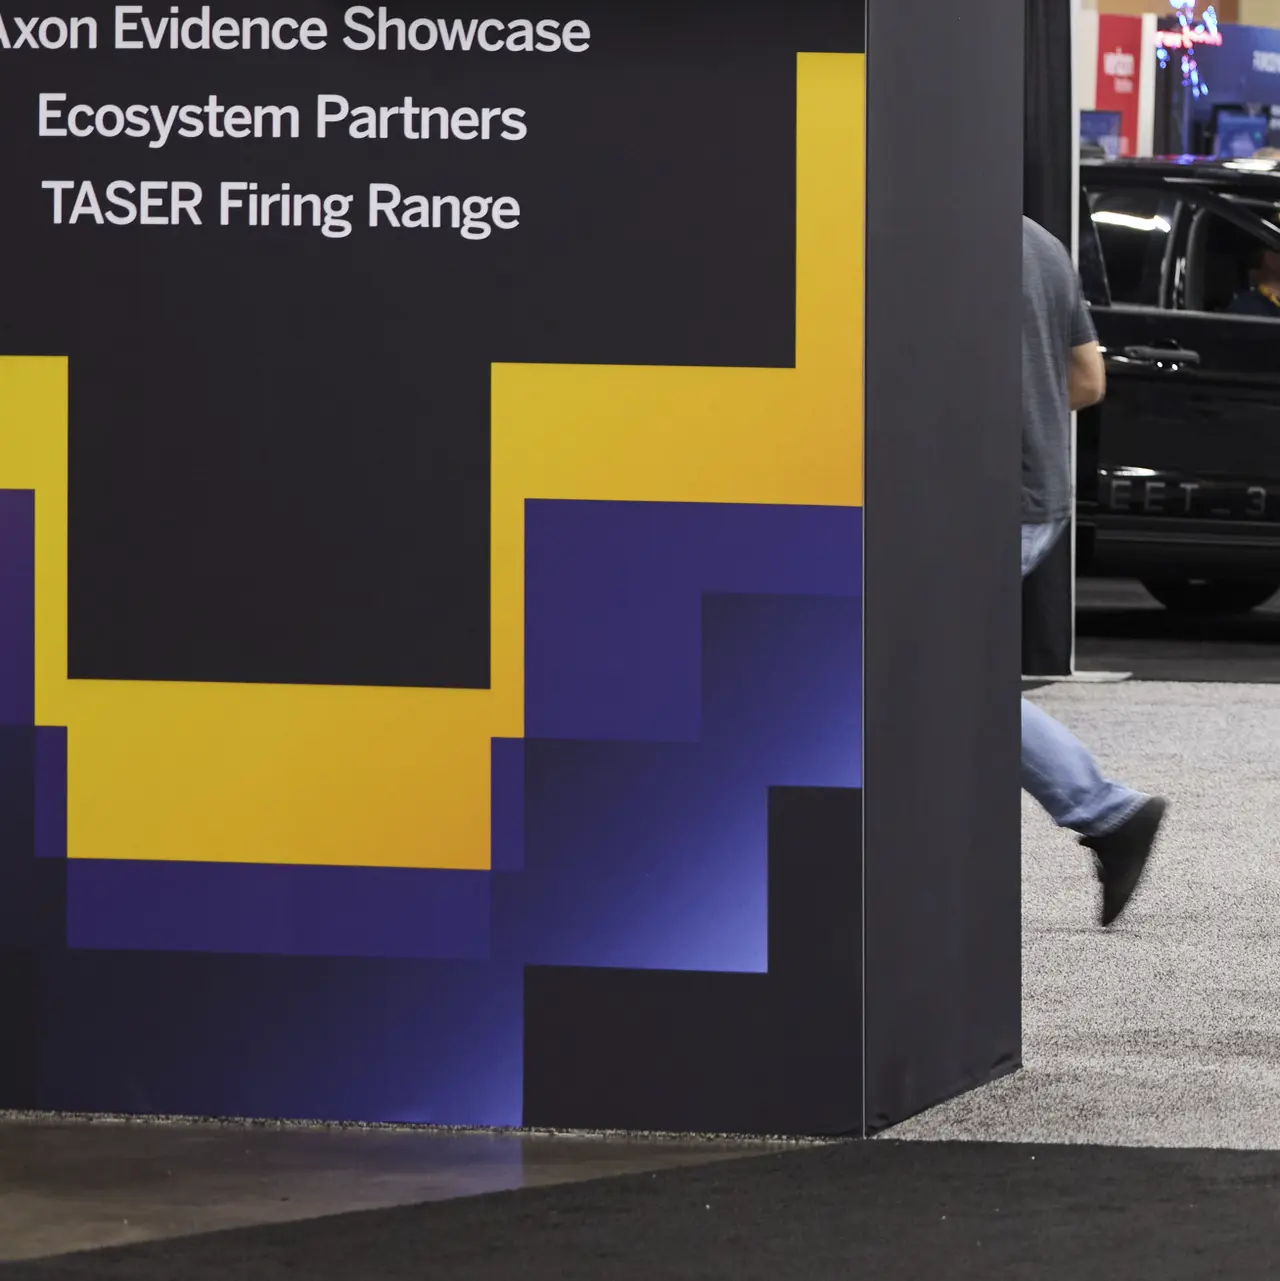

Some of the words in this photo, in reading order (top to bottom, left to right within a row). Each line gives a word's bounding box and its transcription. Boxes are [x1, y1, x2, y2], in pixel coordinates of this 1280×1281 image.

[114, 5, 328, 51] Evidence
[342, 6, 591, 53] Showcase
[38, 93, 300, 149] Ecosystem
[317, 95, 528, 141] Partners
[42, 180, 203, 226] TASER
[220, 182, 354, 239] Firing
[368, 183, 521, 241] Range
